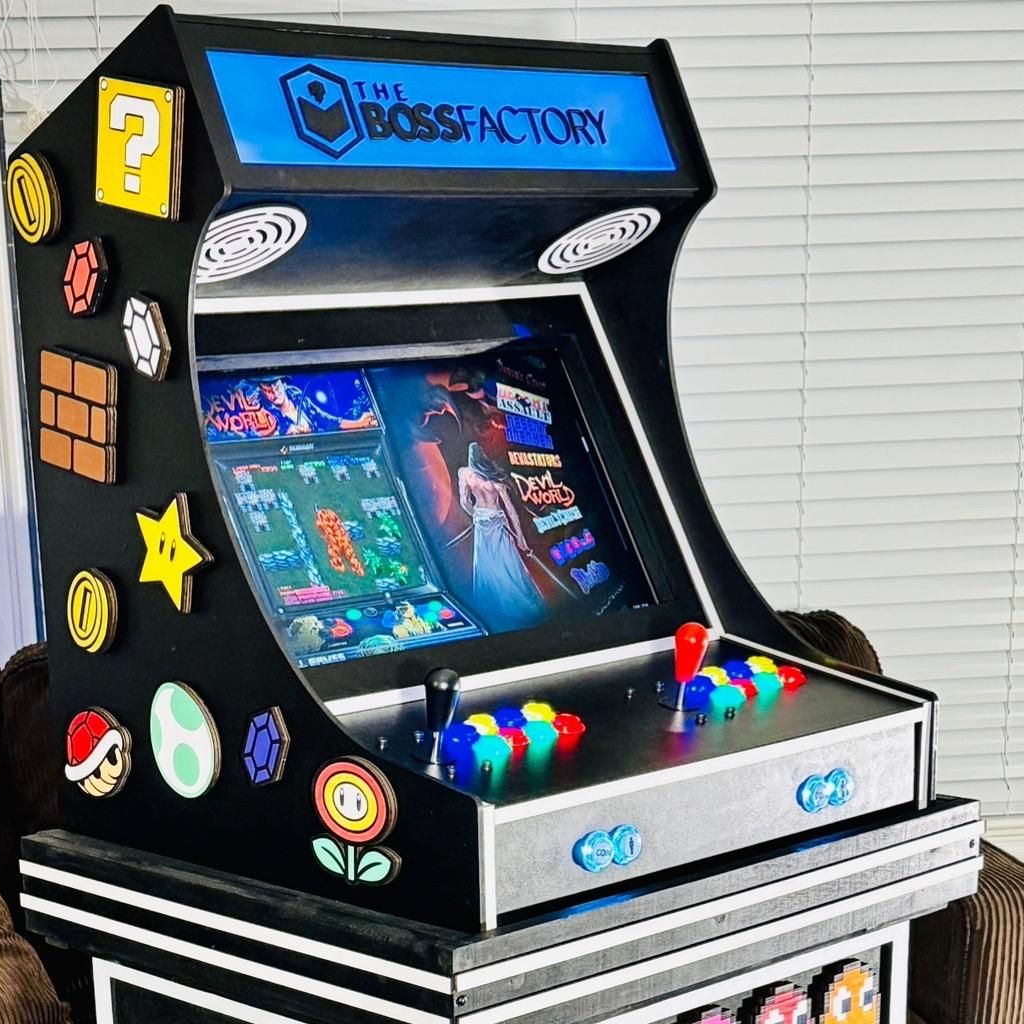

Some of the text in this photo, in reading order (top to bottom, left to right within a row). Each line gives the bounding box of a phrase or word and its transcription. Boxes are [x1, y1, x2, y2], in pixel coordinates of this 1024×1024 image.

[351, 81, 409, 102] THE
[364, 101, 609, 146] BOSSFACTORY
[498, 399, 551, 422] ASSAULT
[214, 411, 278, 437] WORLD
[508, 451, 562, 467] DEVASTATORS
[510, 470, 563, 502] DEVIL
[529, 485, 575, 507] WORLD
